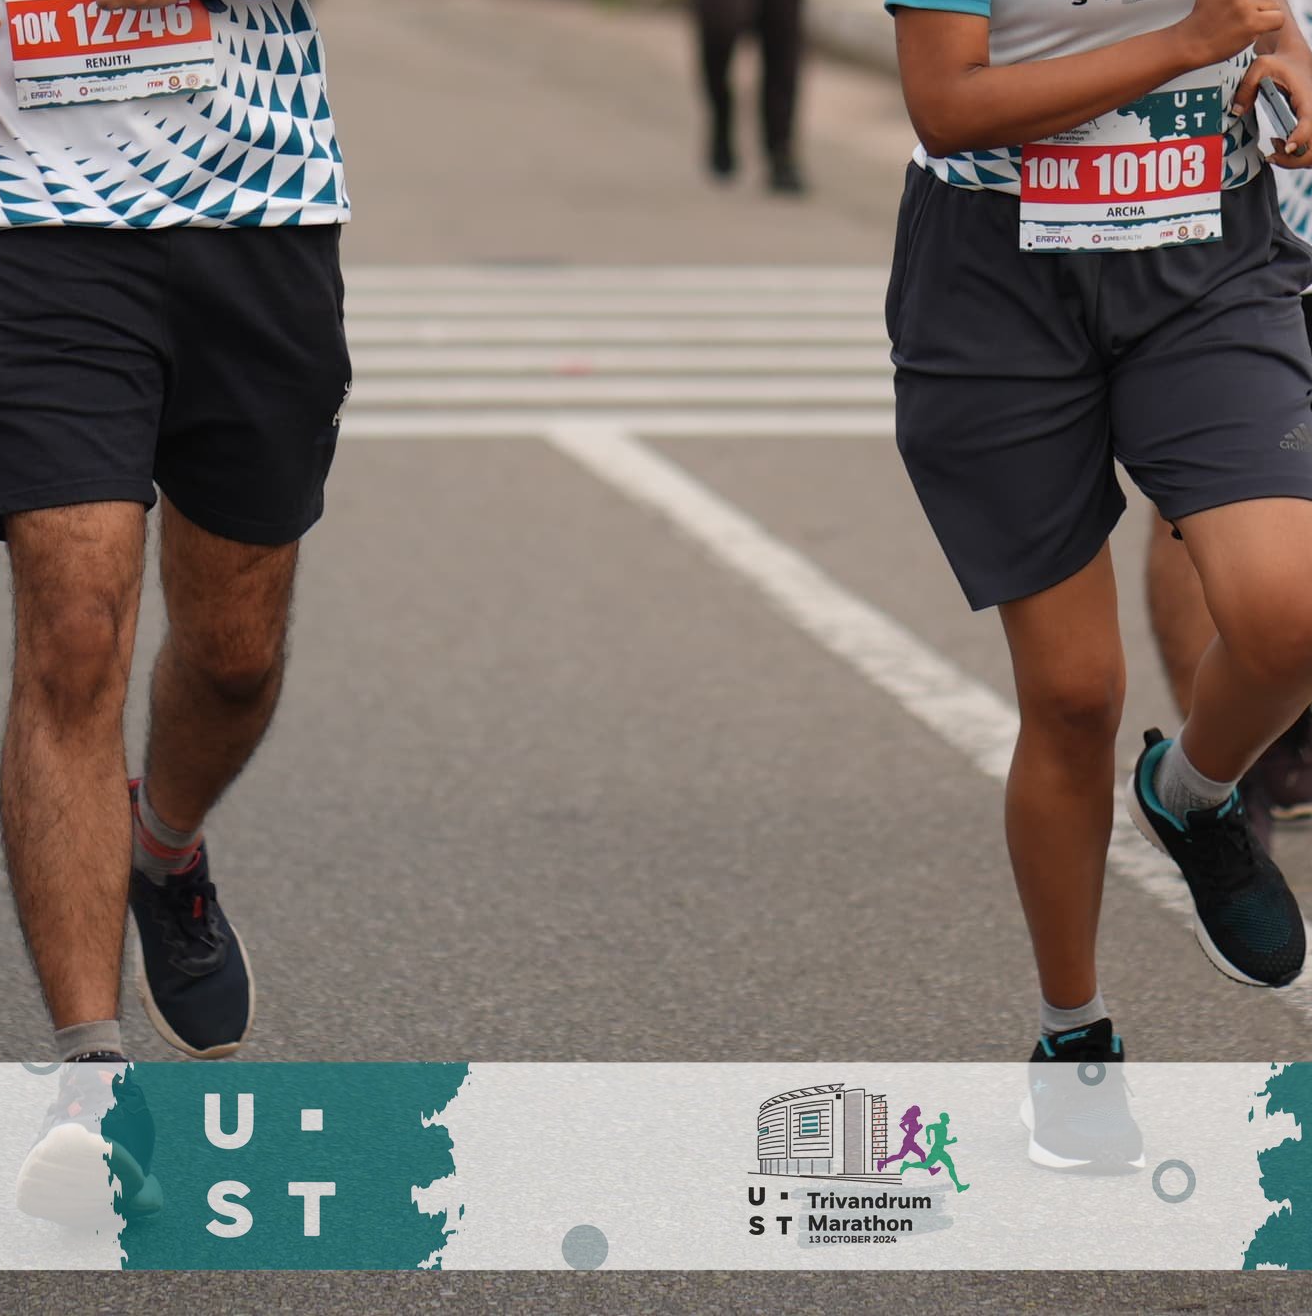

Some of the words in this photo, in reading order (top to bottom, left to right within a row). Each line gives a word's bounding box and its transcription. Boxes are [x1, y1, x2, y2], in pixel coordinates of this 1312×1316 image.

[11, 11, 61, 45] 10K
[85, 54, 131, 69] RENJITH
[1024, 157, 1080, 190] 10K
[1092, 144, 1206, 196] 10103
[1106, 205, 1145, 218] ARCHA
